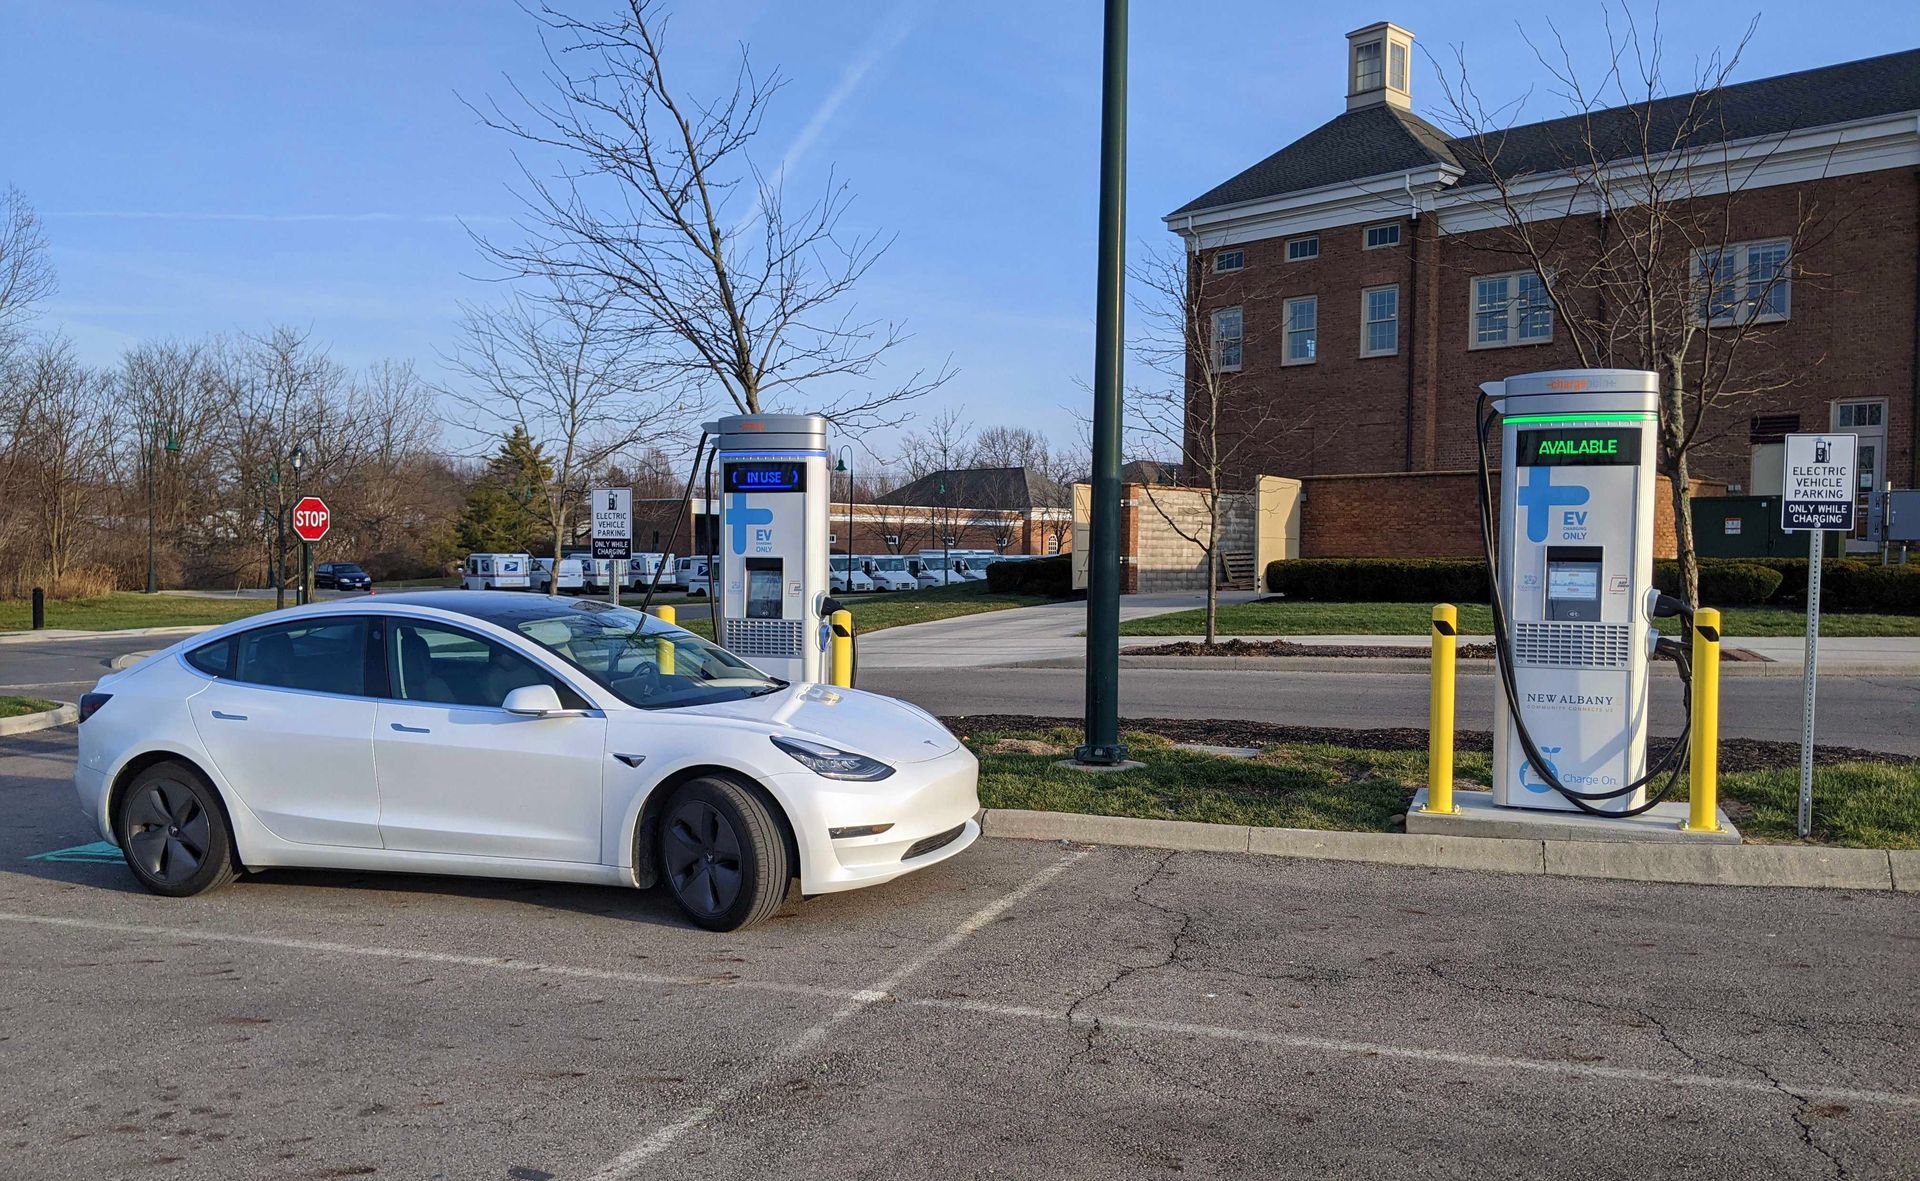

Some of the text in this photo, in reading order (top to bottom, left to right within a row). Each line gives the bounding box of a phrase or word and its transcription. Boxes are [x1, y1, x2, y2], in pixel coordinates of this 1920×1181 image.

[1539, 439, 1618, 455] AVAILABLE
[1793, 466, 1847, 476] ELECTRIC
[747, 471, 782, 483] IN USE
[1796, 478, 1843, 487] VEHICLE
[1794, 489, 1843, 499] PARKING
[1788, 504, 1848, 514] ONLY WHILE
[296, 510, 327, 527] STOP
[596, 512, 627, 520] ELECTRIC
[1563, 511, 1588, 526] EV
[1792, 514, 1843, 524] CHARGING
[598, 521, 625, 529] VEHICLE
[597, 529, 626, 537] PARKING
[755, 529, 772, 541] EV
[1562, 532, 1588, 540] ONLY
[595, 540, 629, 548] ONLY WHILE
[597, 548, 626, 556] CHARGING
[1527, 693, 1613, 706] NEW ALBANY
[1563, 773, 1617, 785] Charge On
